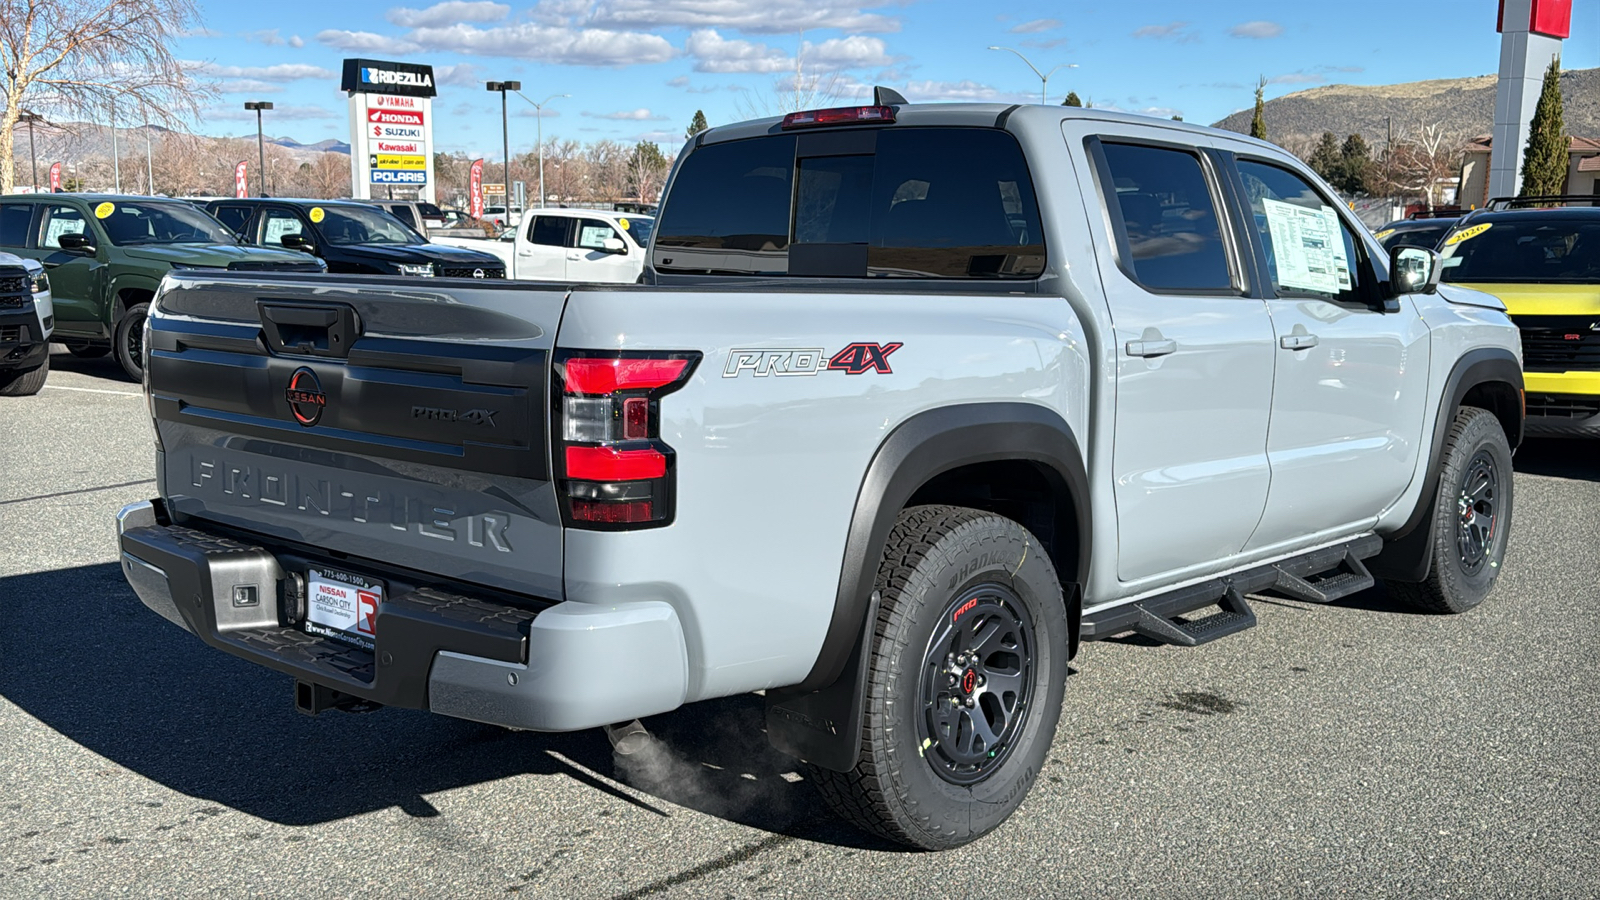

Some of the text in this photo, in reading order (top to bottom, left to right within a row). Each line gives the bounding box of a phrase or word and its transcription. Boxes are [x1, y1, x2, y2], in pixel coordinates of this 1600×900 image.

[379, 70, 432, 87] RIDEZILLA
[385, 97, 414, 107] YAMAHA
[381, 113, 421, 123] HONDA
[385, 127, 420, 137] SUZUKI
[378, 142, 417, 152] Kawasaki
[373, 171, 425, 182] POLARIS
[1454, 225, 1484, 241] 2026
[287, 391, 326, 405] NISSAN
[190, 454, 513, 553] FRONTIER
[323, 569, 364, 586] 775-600-1500
[319, 585, 347, 598] NISSAN
[315, 593, 352, 609] CARSON CITY
[953, 598, 978, 622] PRO
